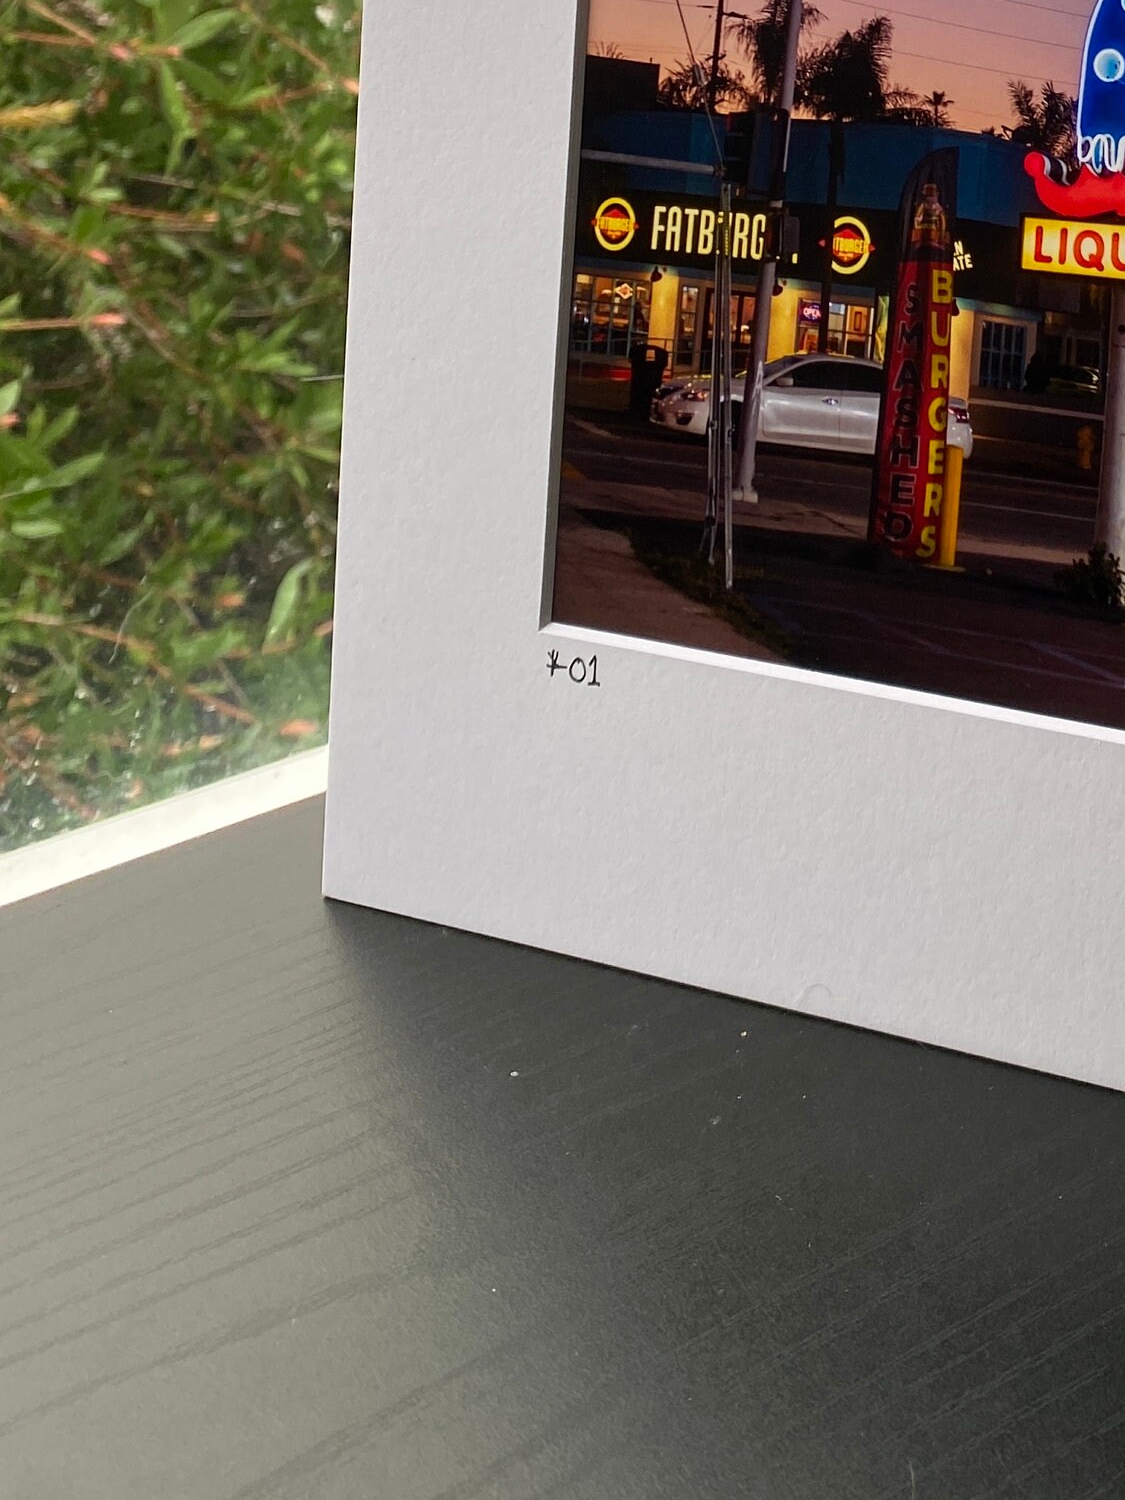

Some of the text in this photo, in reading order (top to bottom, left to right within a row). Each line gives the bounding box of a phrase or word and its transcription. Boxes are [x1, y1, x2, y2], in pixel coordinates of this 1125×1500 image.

[651, 205, 798, 264] FATBRG
[883, 283, 924, 542] SMASHED
[915, 268, 953, 558] BURGERS
